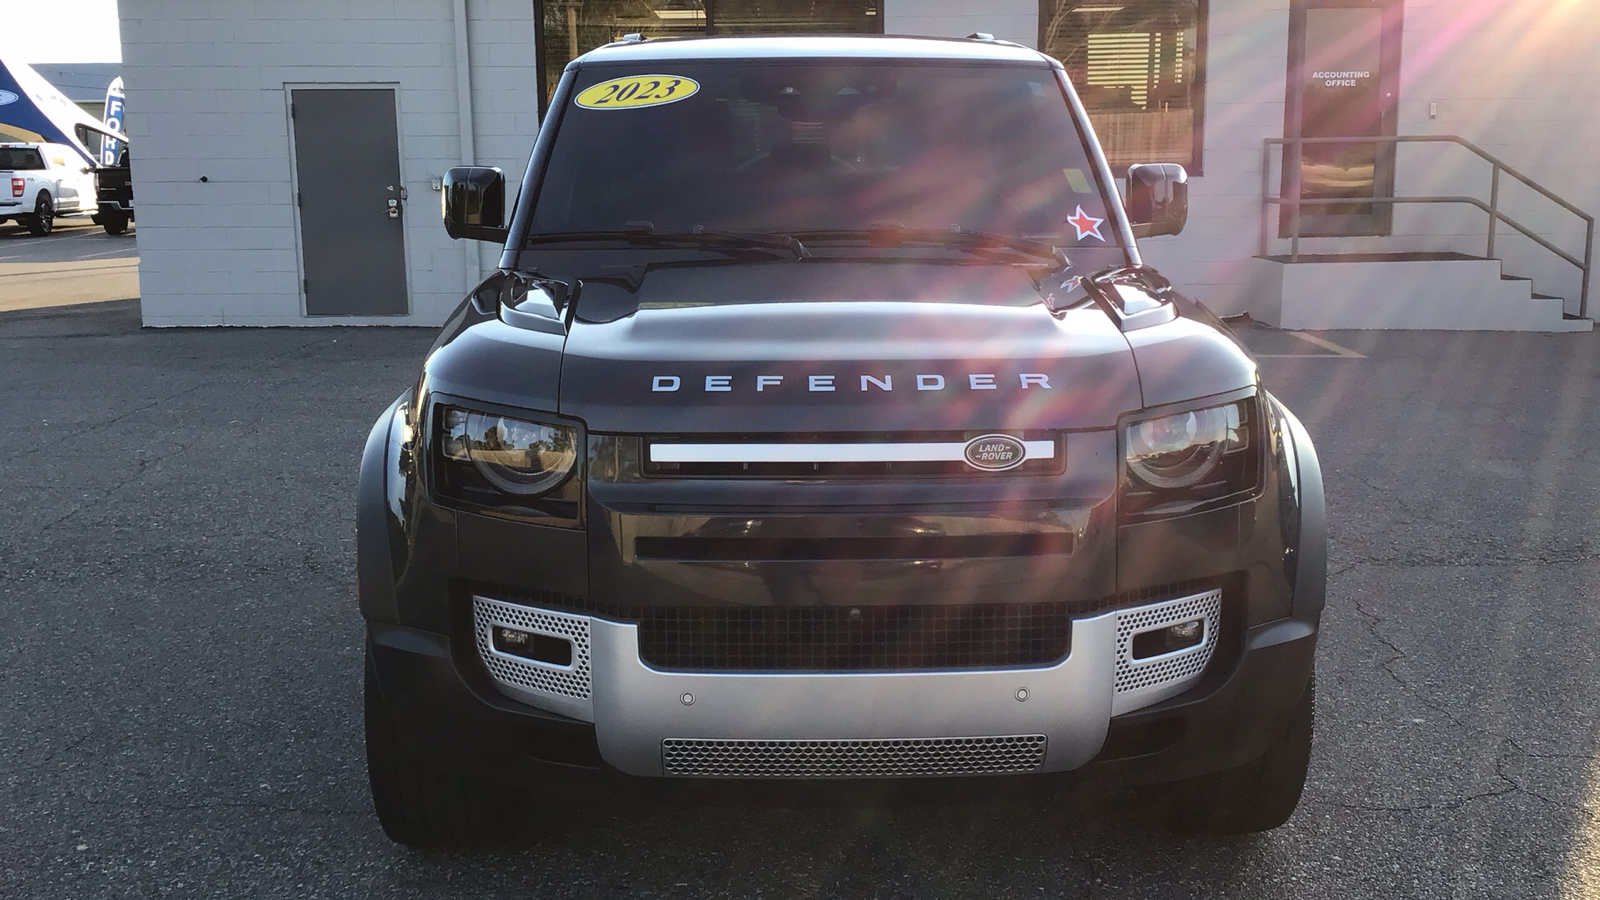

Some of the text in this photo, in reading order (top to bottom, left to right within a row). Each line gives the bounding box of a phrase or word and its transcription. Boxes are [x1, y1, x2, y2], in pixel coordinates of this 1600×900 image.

[1312, 71, 1370, 79] ACCOUNTING
[1325, 79, 1357, 87] OFFICE
[593, 79, 681, 105] 2023
[104, 100, 122, 165] FORD
[651, 373, 1052, 392] DEFENDER
